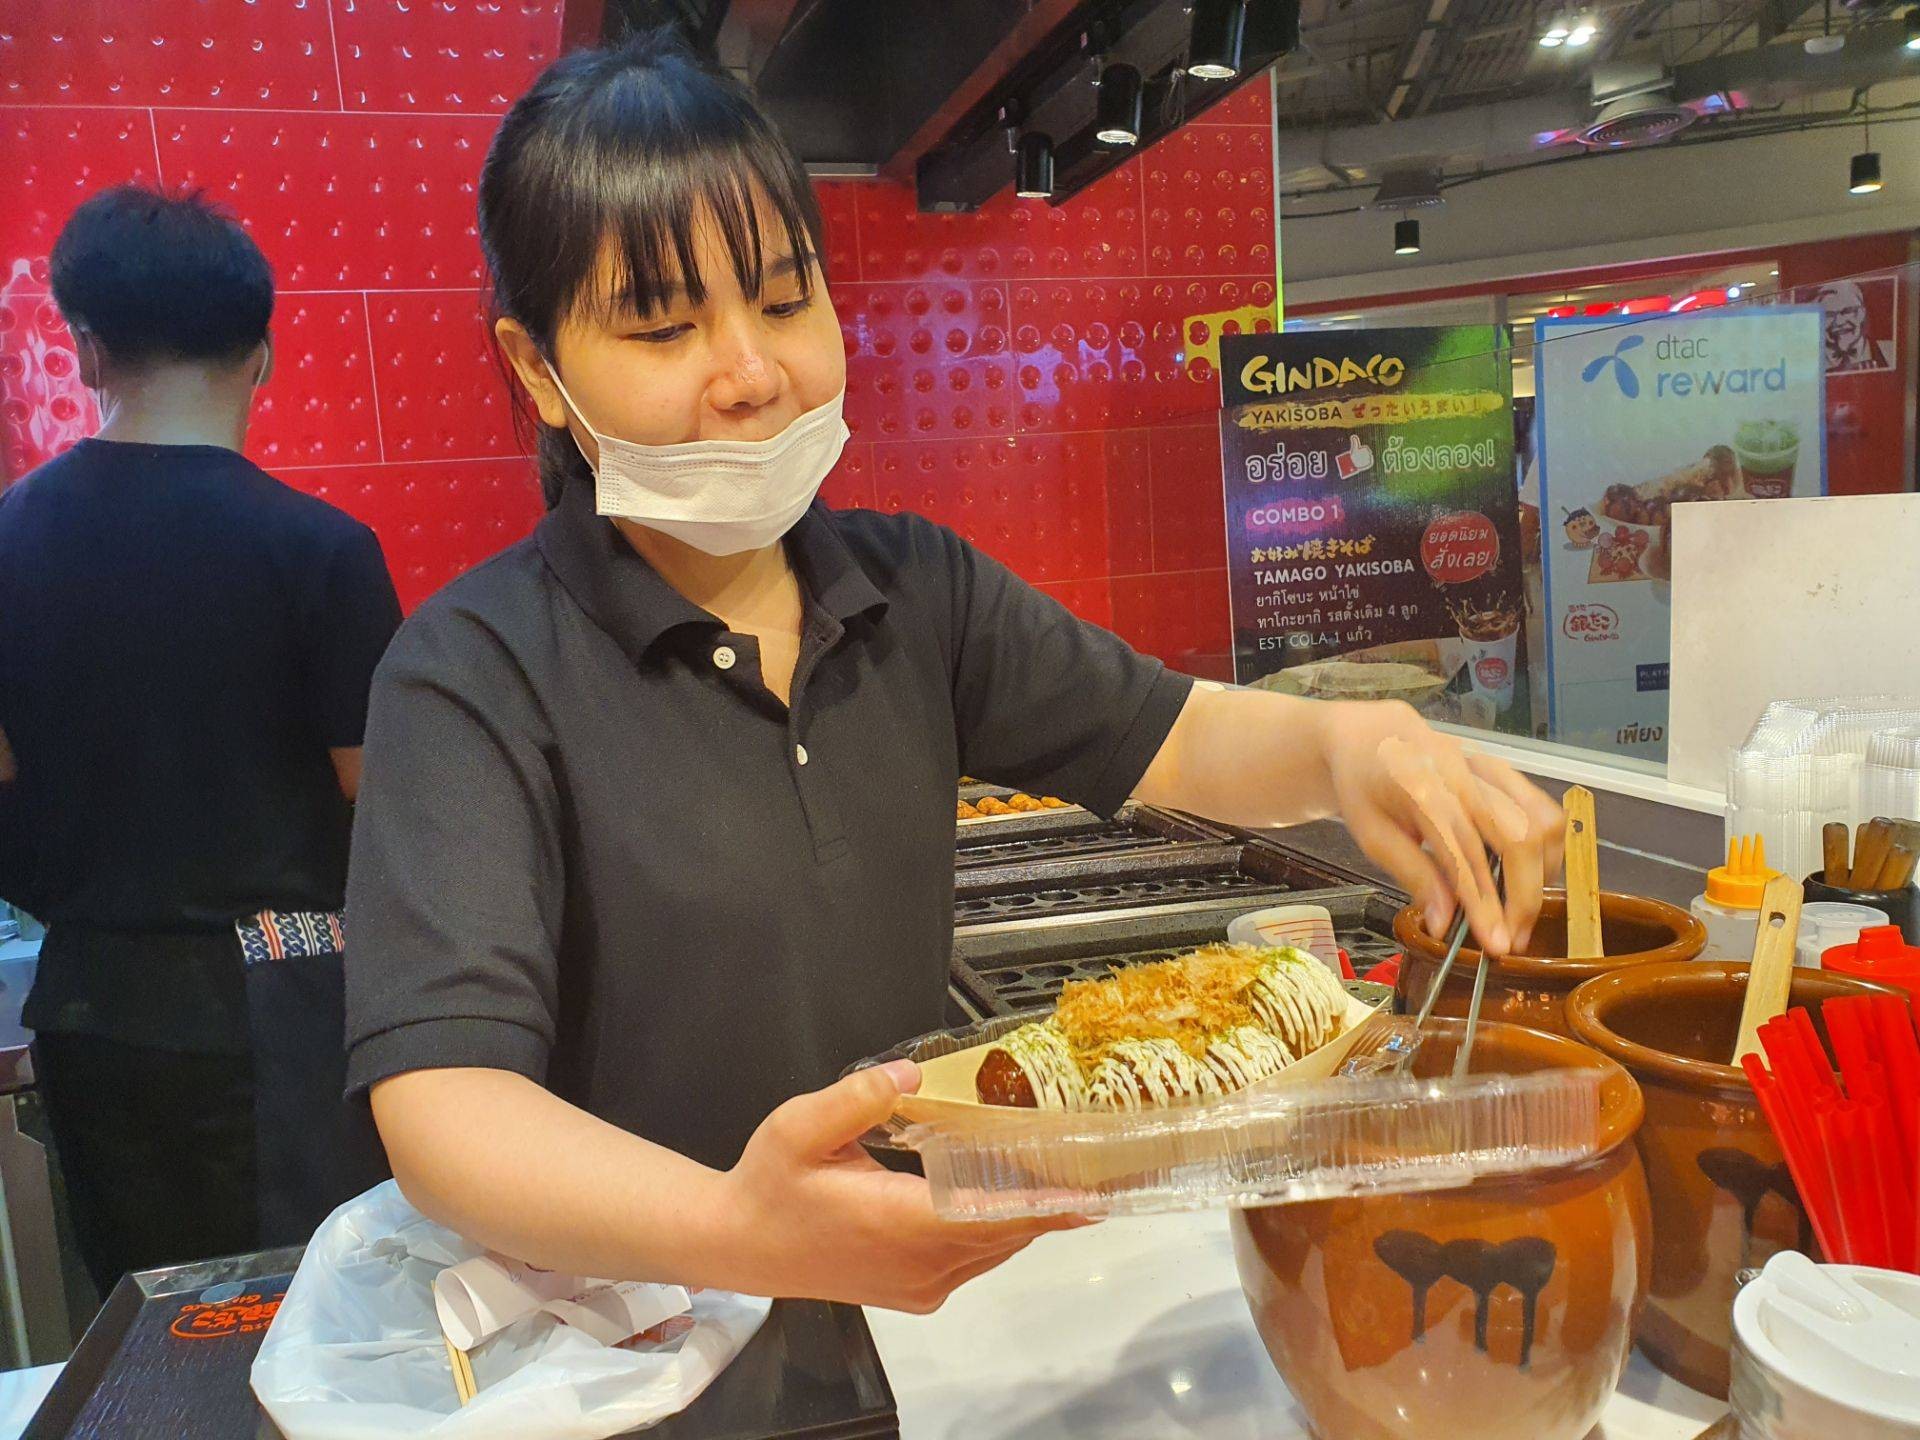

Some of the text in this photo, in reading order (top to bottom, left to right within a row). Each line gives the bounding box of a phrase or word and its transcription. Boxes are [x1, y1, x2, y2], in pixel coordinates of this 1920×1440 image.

[1656, 334, 1709, 360] dtac
[1241, 354, 1405, 394] GINDACO
[1657, 358, 1786, 397] reward
[1252, 406, 1342, 424] YAKISOBA
[1246, 436, 1495, 482] อร่อย ต้องลอง!
[1252, 504, 1339, 525] COMBO 1
[1431, 543, 1490, 569] สั่งเลย
[1254, 559, 1415, 585] TAMAGO YAKISOBA
[1318, 584, 1360, 601] หน้าไข่
[1257, 600, 1418, 629] ทาโกะยากิ รสดั้งเดิม 4 ลูก
[1259, 625, 1372, 650] EST COLA 1 แก้ว
[1616, 722, 1664, 744] เพียง
